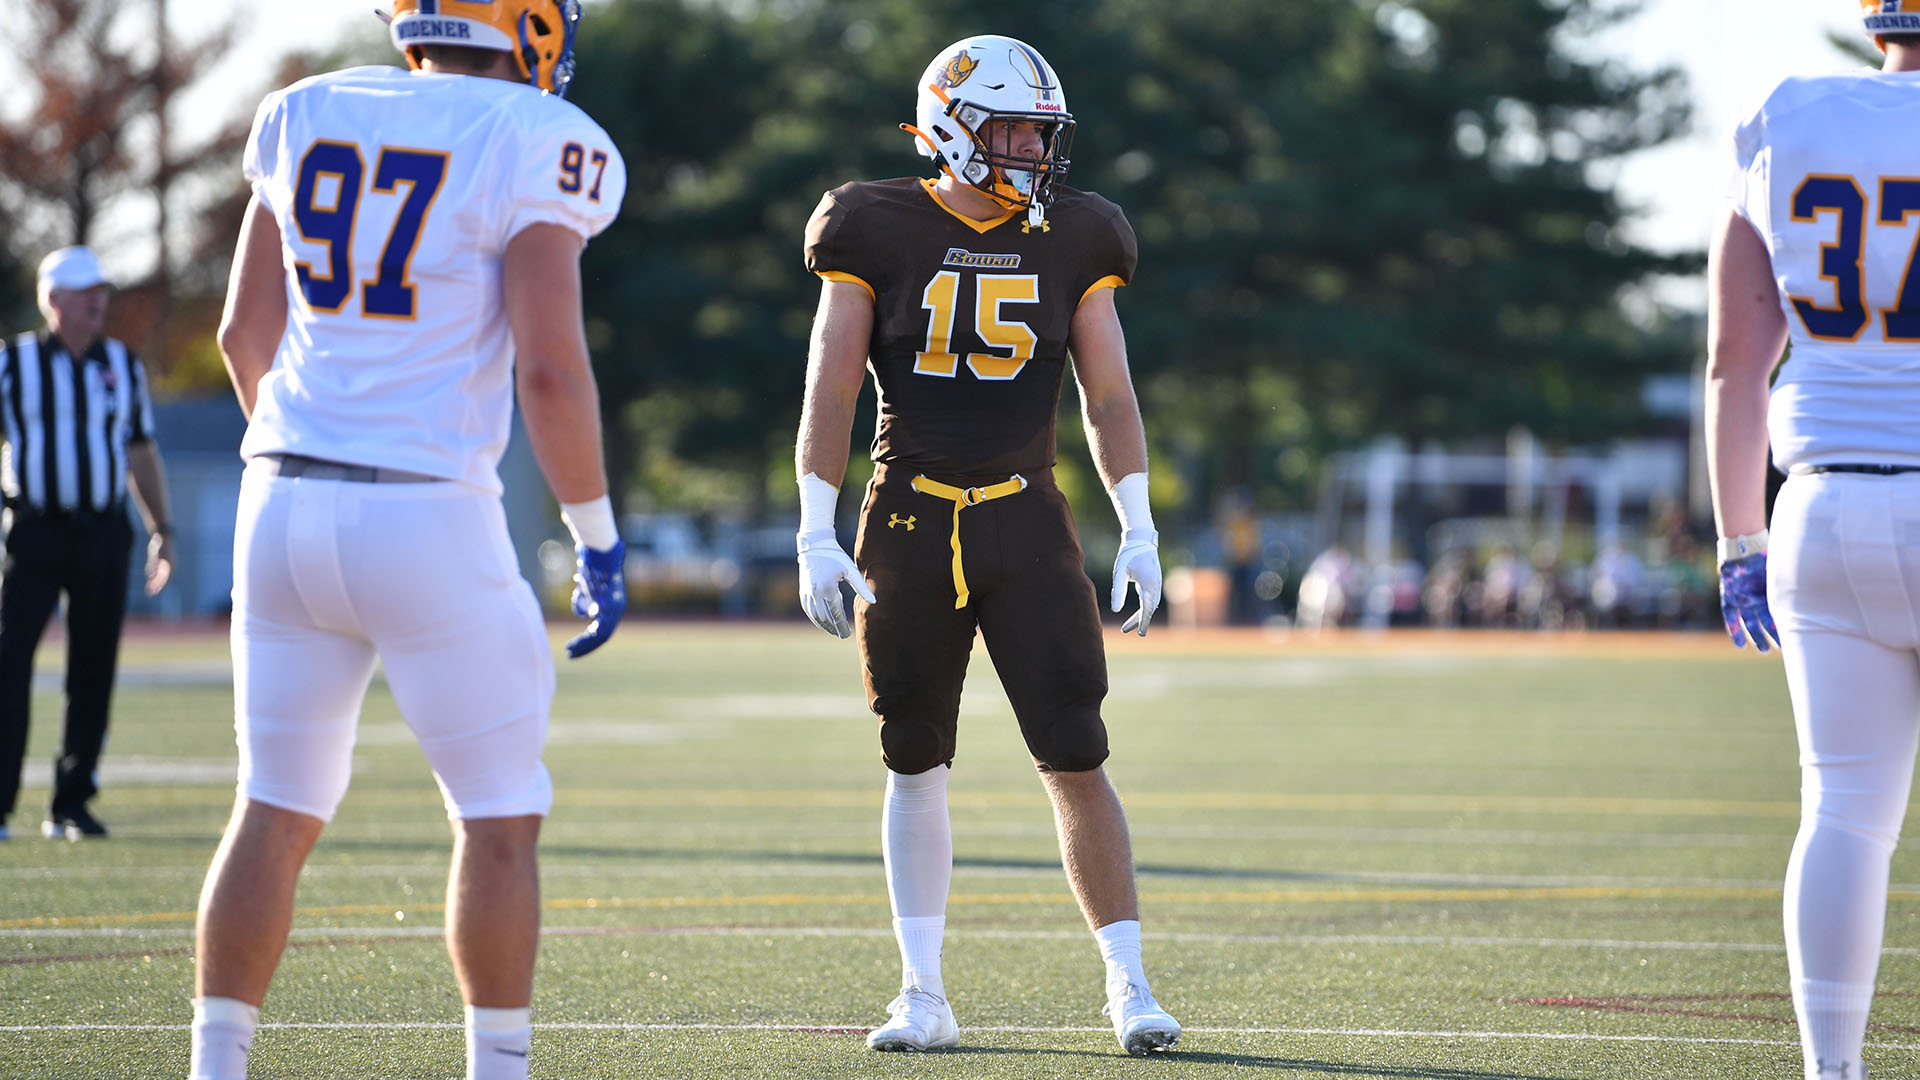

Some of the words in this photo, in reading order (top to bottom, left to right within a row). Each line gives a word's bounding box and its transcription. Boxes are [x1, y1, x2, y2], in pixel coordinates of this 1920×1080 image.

[396, 19, 471, 40] WIDENER
[1035, 103, 1061, 111] Riddell
[557, 141, 607, 204] 97
[293, 138, 451, 321] 97
[945, 249, 1020, 267] Rowan
[1790, 173, 1920, 342] 37
[913, 270, 1040, 380] 15
